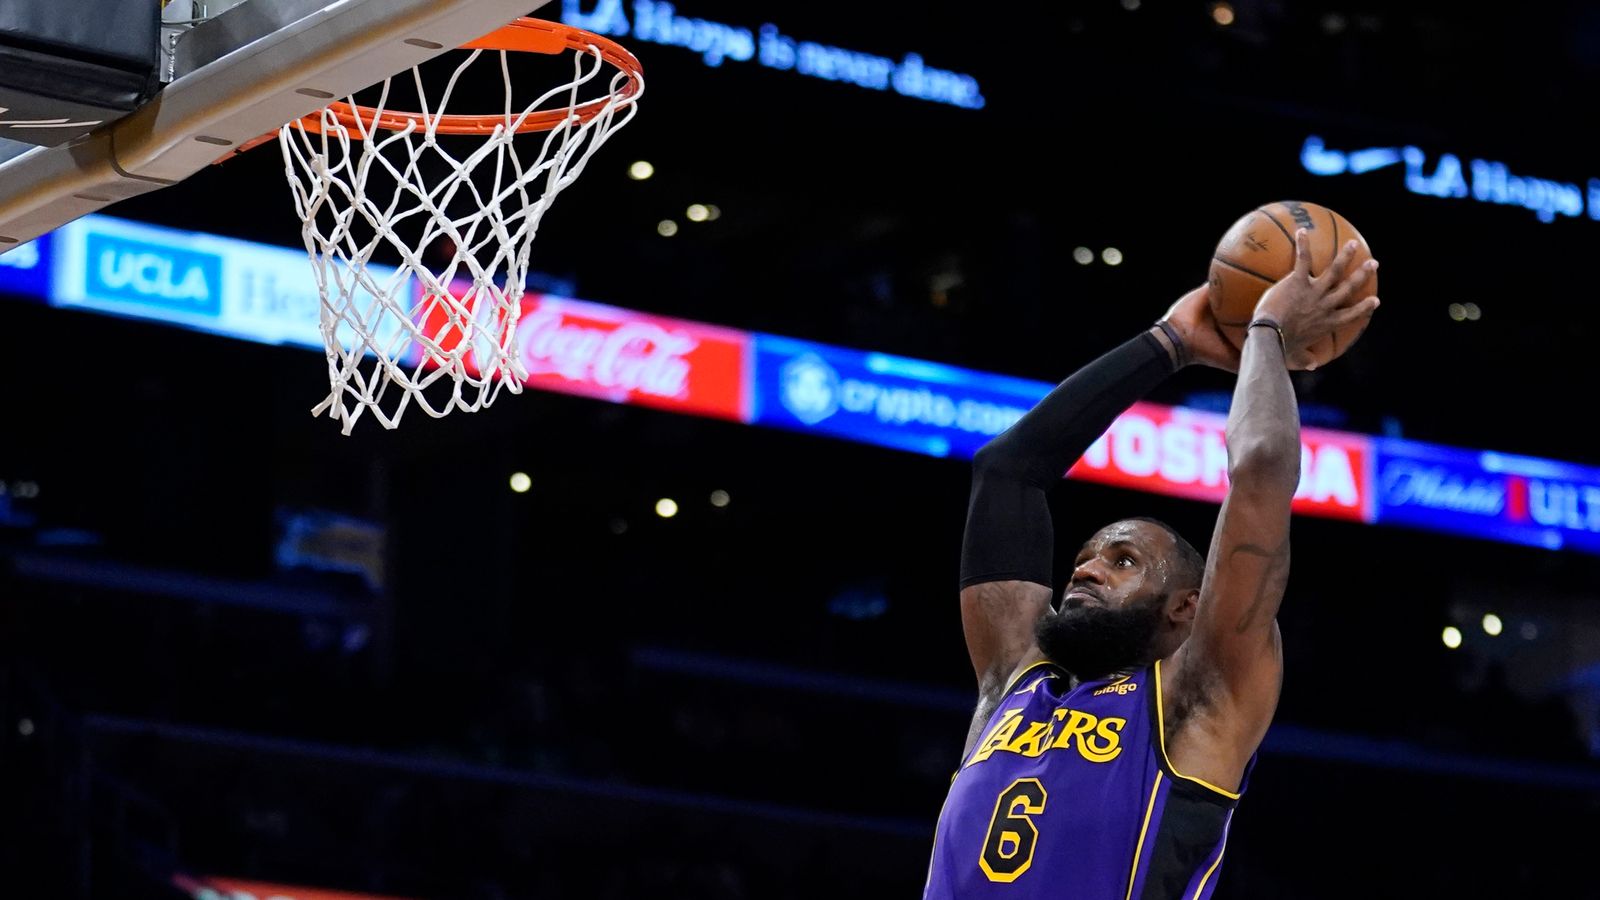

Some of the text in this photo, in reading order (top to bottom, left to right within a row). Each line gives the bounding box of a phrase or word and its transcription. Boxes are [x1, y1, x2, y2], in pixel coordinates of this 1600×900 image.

[633, 0, 755, 67] Hoops
[759, 22, 796, 70] is
[796, 41, 895, 90] never
[1471, 158, 1584, 223] Hoops
[100, 248, 209, 301] UCLA
[1084, 415, 1358, 507] TOSHA
[1093, 682, 1137, 696] bibigo
[965, 708, 1126, 768] LAKERS
[978, 777, 1048, 883] 6
